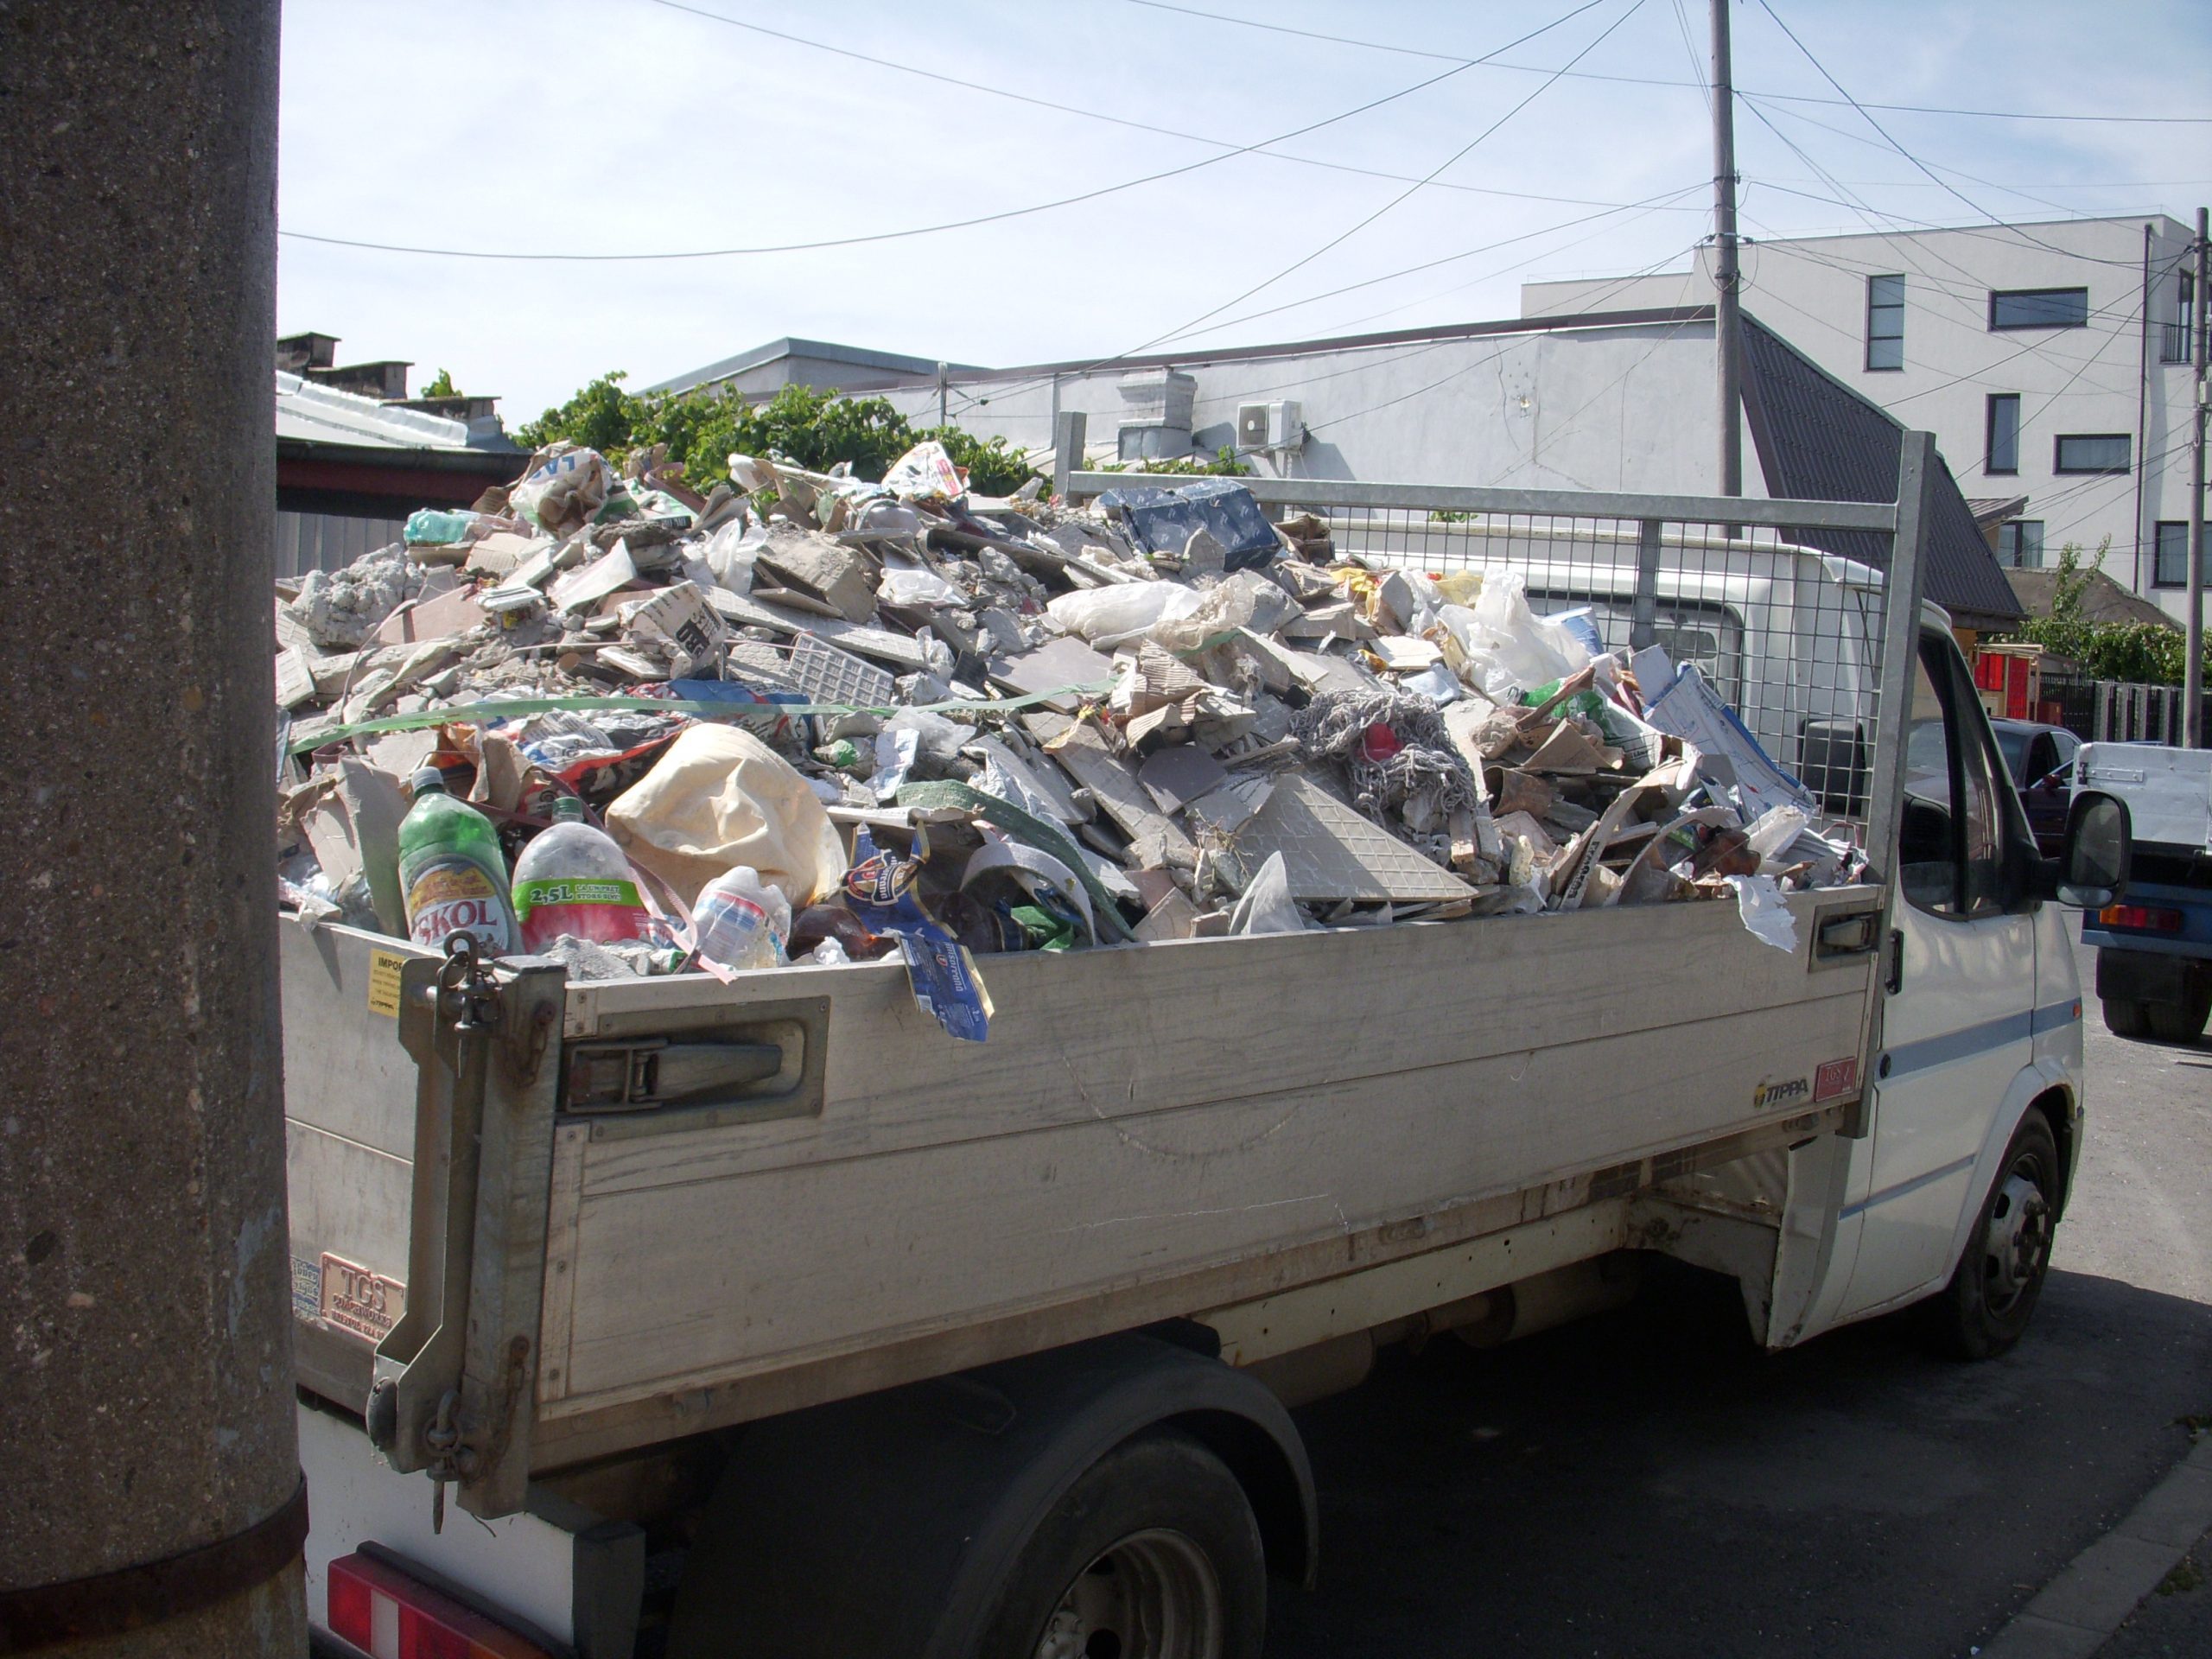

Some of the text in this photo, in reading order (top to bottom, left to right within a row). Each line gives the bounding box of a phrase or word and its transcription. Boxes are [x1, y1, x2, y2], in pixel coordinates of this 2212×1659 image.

[530, 885, 574, 906] 2,5L
[418, 899, 498, 946] SKOL
[1765, 1078, 1808, 1103] TIPPA
[340, 1266, 386, 1312] TGS
